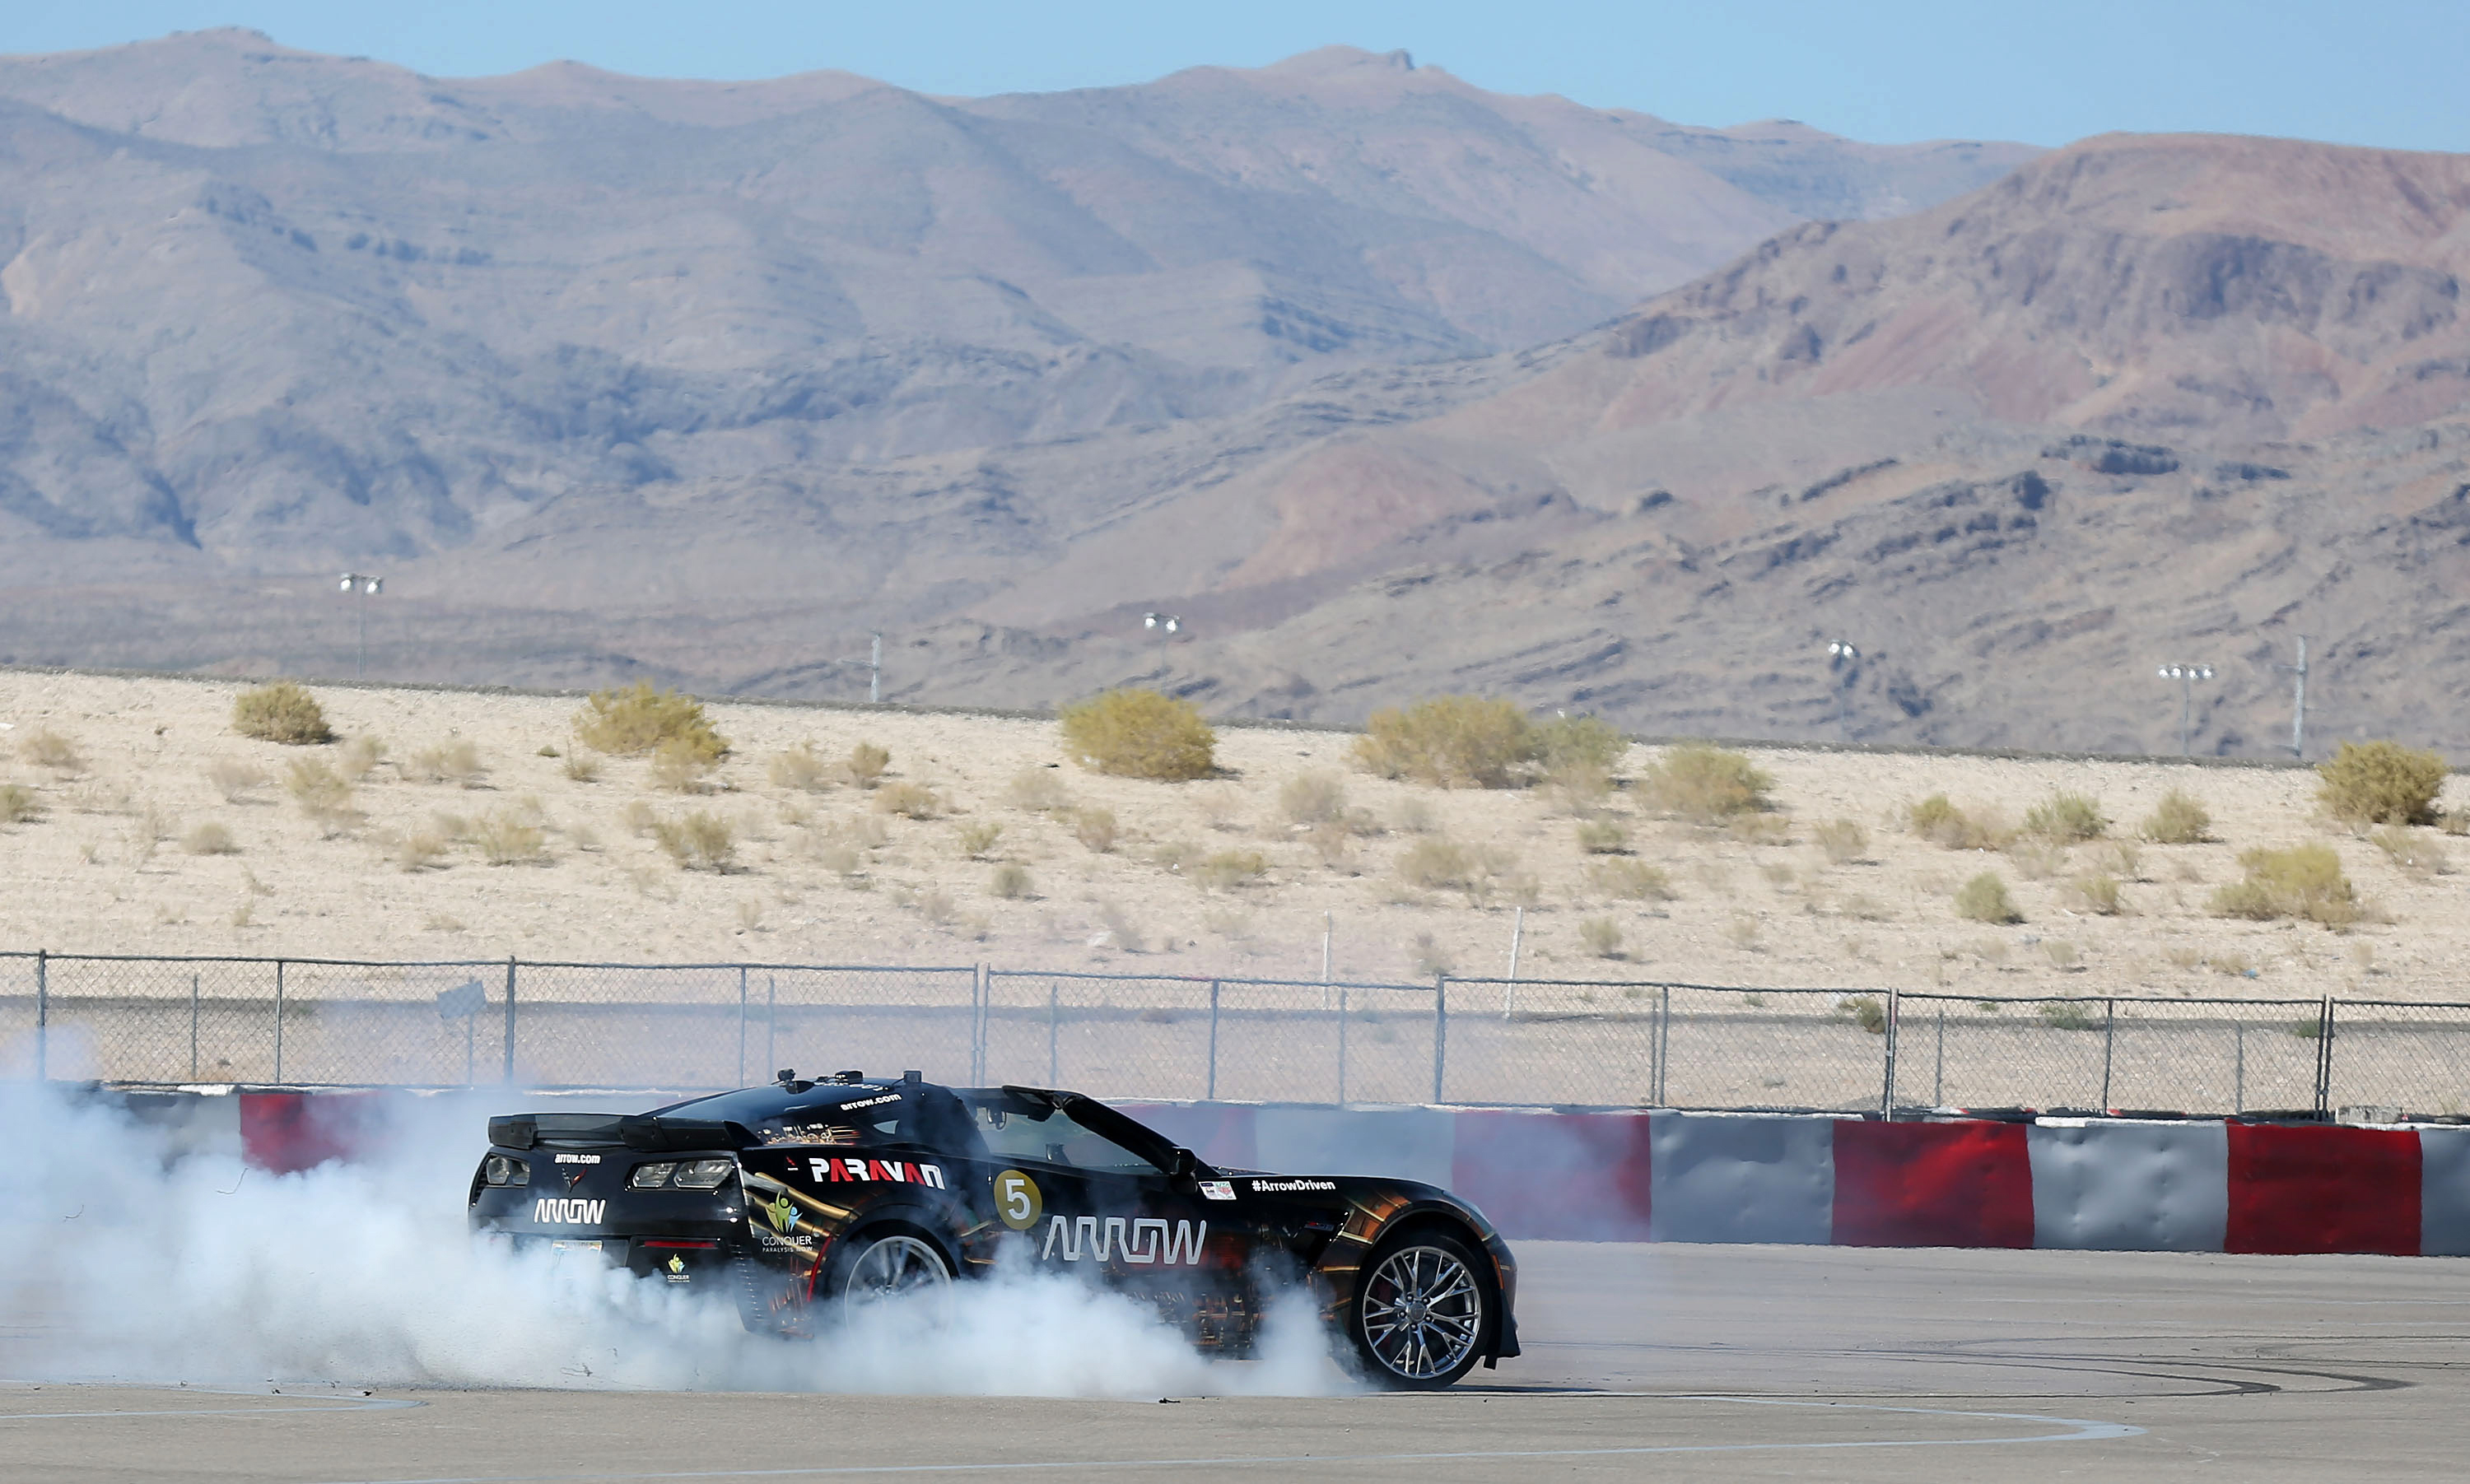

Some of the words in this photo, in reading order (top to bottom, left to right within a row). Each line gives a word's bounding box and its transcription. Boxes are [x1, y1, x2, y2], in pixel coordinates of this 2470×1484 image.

[840, 1093, 902, 1111] arrow.com
[554, 1153, 601, 1165] arrow.com
[809, 1157, 946, 1190] PARAVAN
[1251, 1179, 1336, 1192] #ArrowDriven
[1004, 1179, 1032, 1221] 5
[534, 1198, 607, 1225] ARROW
[762, 1235, 813, 1246] CONQUER
[1042, 1215, 1208, 1266] ARROW
